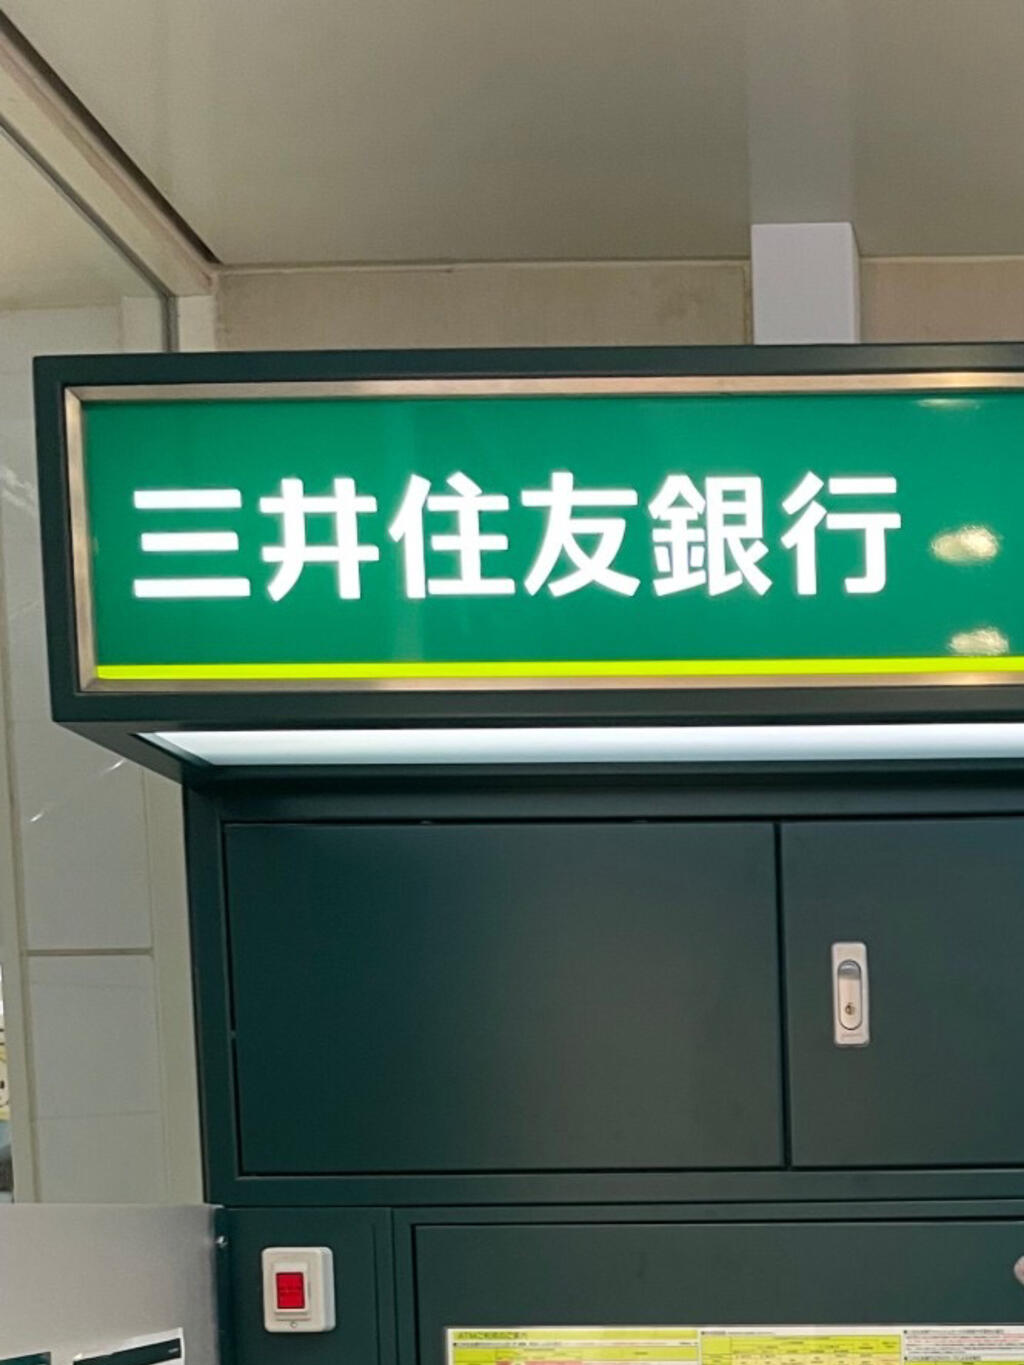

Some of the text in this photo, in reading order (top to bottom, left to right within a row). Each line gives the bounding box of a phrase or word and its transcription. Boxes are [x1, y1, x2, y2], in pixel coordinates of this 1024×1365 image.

[133, 471, 902, 601] 三井住友銀行
